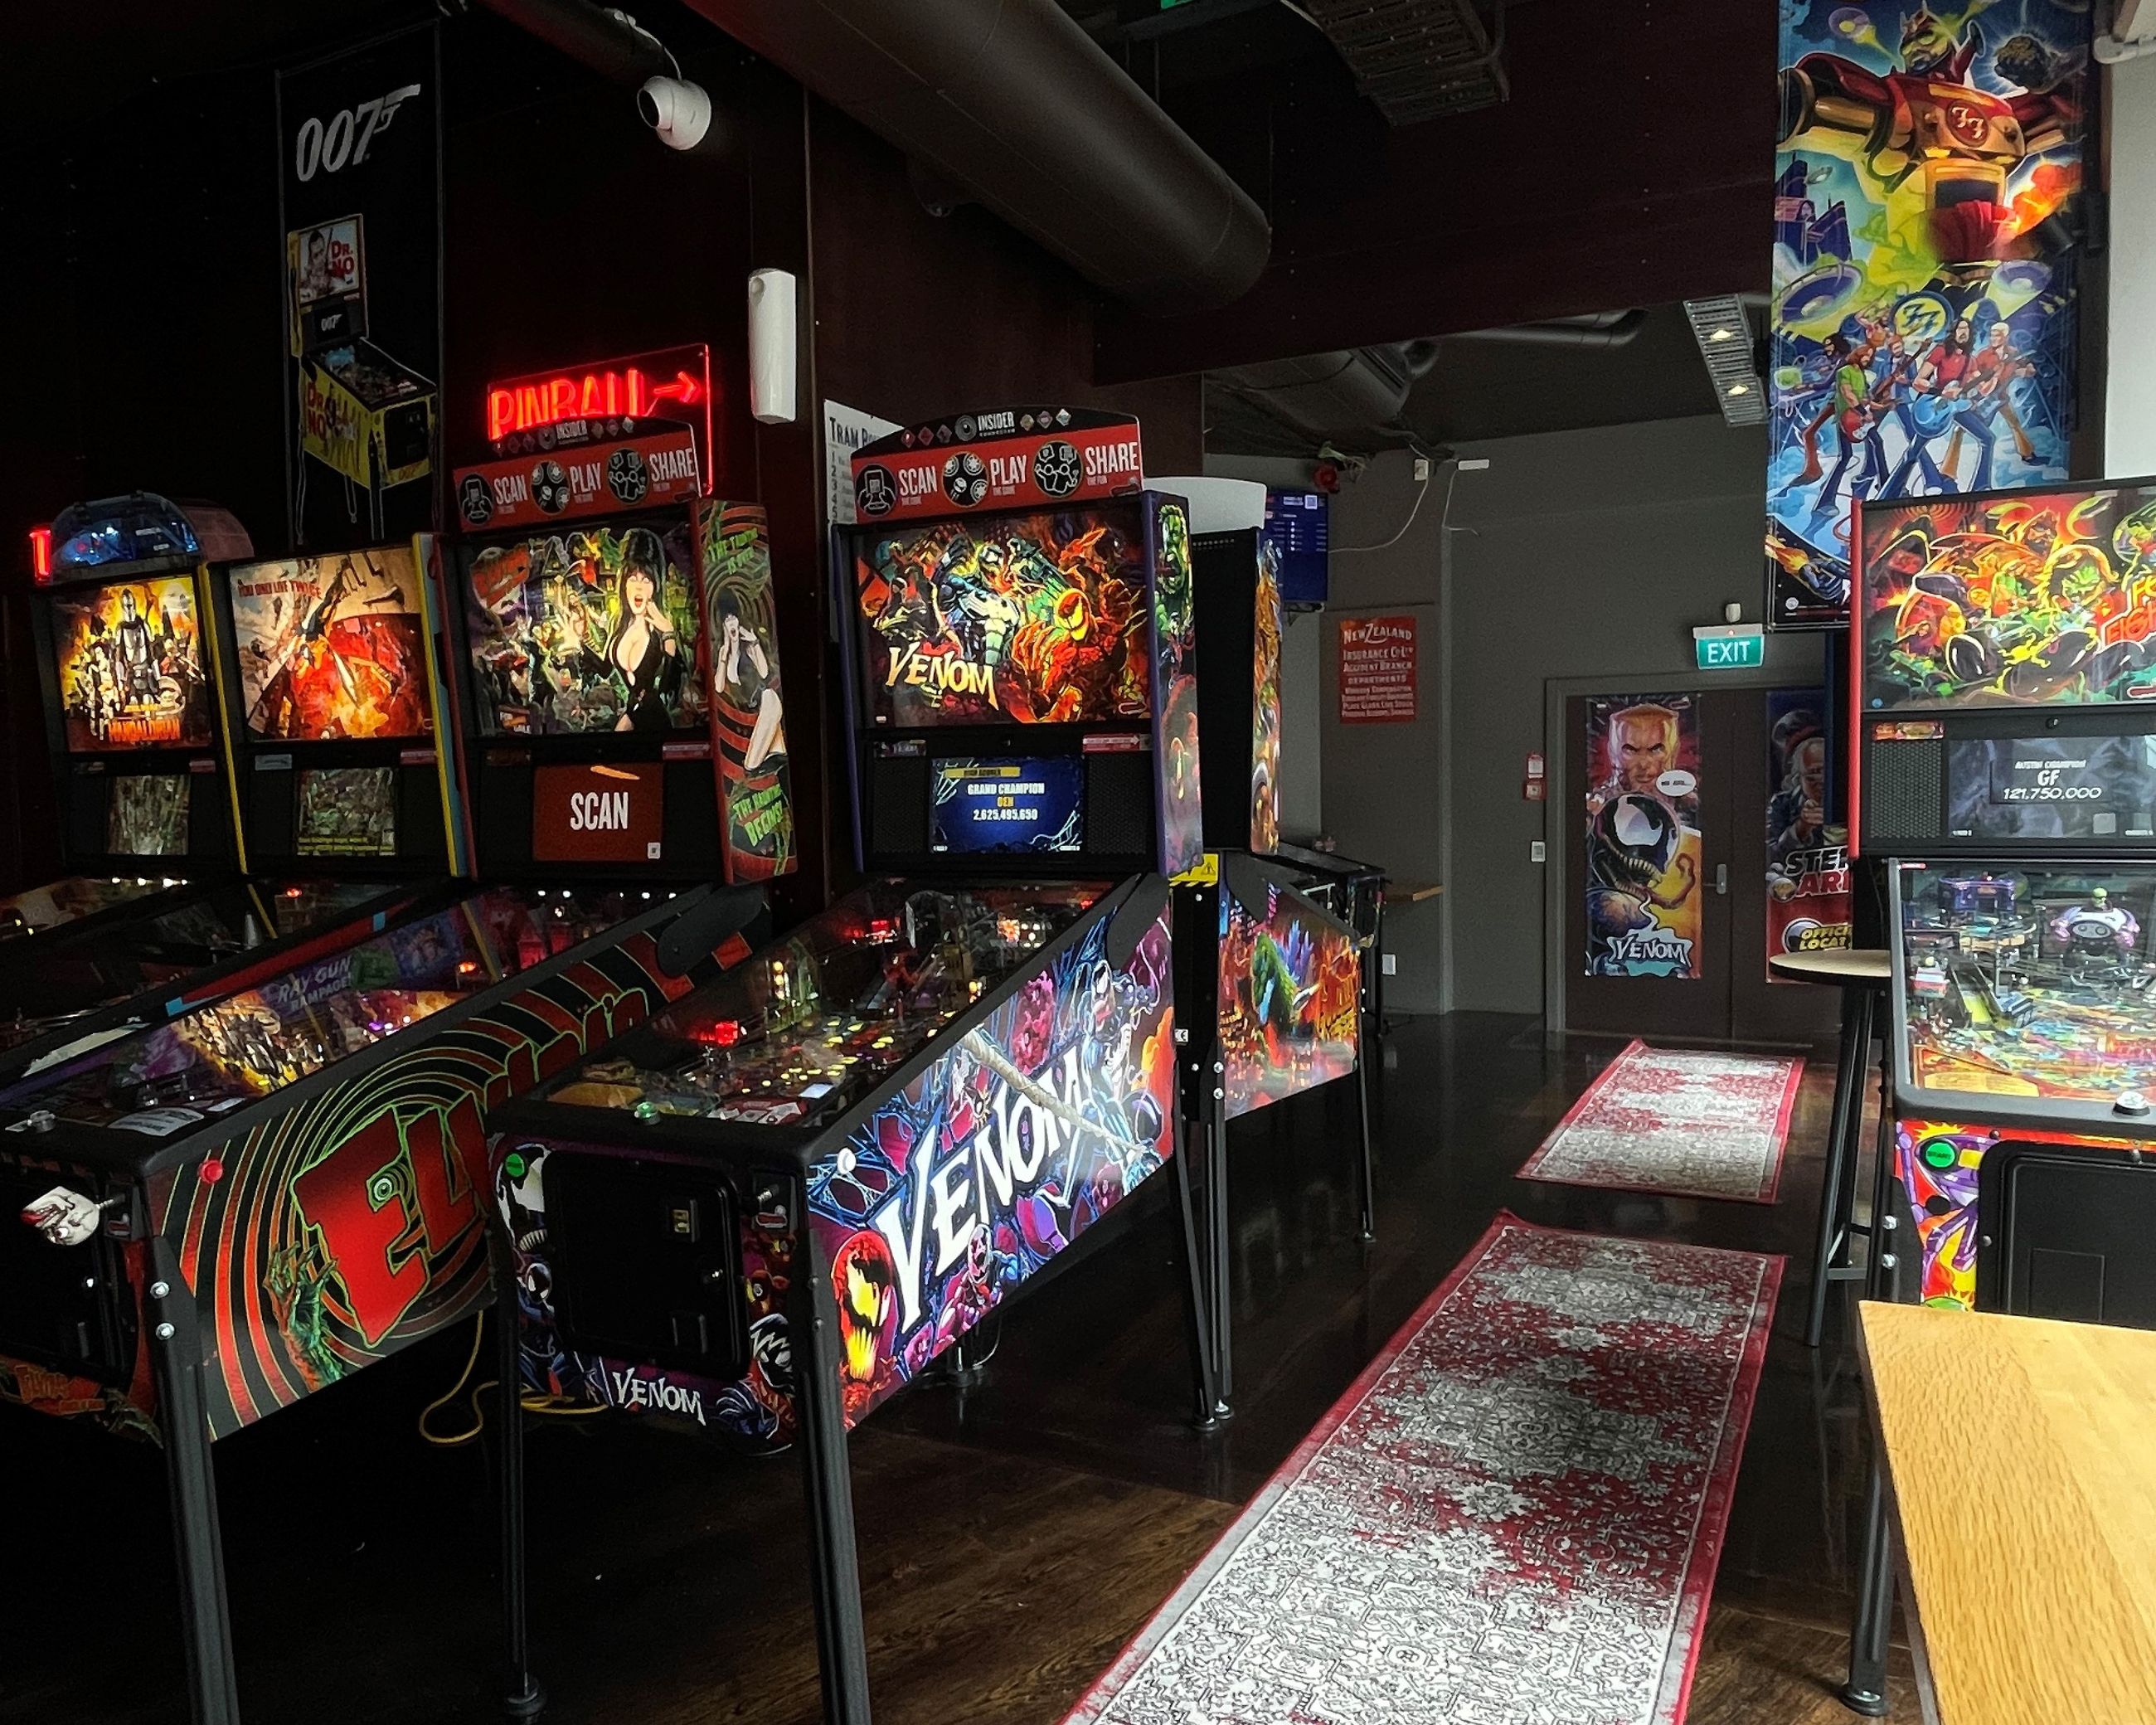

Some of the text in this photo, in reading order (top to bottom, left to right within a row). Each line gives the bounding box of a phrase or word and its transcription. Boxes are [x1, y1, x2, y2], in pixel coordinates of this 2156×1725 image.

[296, 91, 398, 182] 007
[489, 369, 645, 440] PINBALL
[829, 416, 858, 449] TRAM
[978, 411, 1014, 431] INSIDER
[649, 448, 697, 482] SHARE
[989, 454, 1027, 486] PLAY
[1085, 441, 1139, 476] SHARE
[493, 474, 527, 505] SCAN
[570, 462, 602, 494] PLAY
[898, 466, 938, 498] SCAN
[1343, 623, 1412, 644] NEW ZEALAND
[1708, 641, 1751, 663] EXIT
[886, 641, 999, 711] VENOM
[968, 783, 1045, 794] GRAND CHAMPION
[2037, 770, 2060, 786] GF
[570, 792, 629, 830] SCAN
[1801, 926, 1850, 940] OFFICI
[1616, 935, 1686, 965] VENOM
[315, 955, 352, 984] GUN
[873, 1047, 1089, 1333] VENOM
[612, 1367, 707, 1426] VENOM
